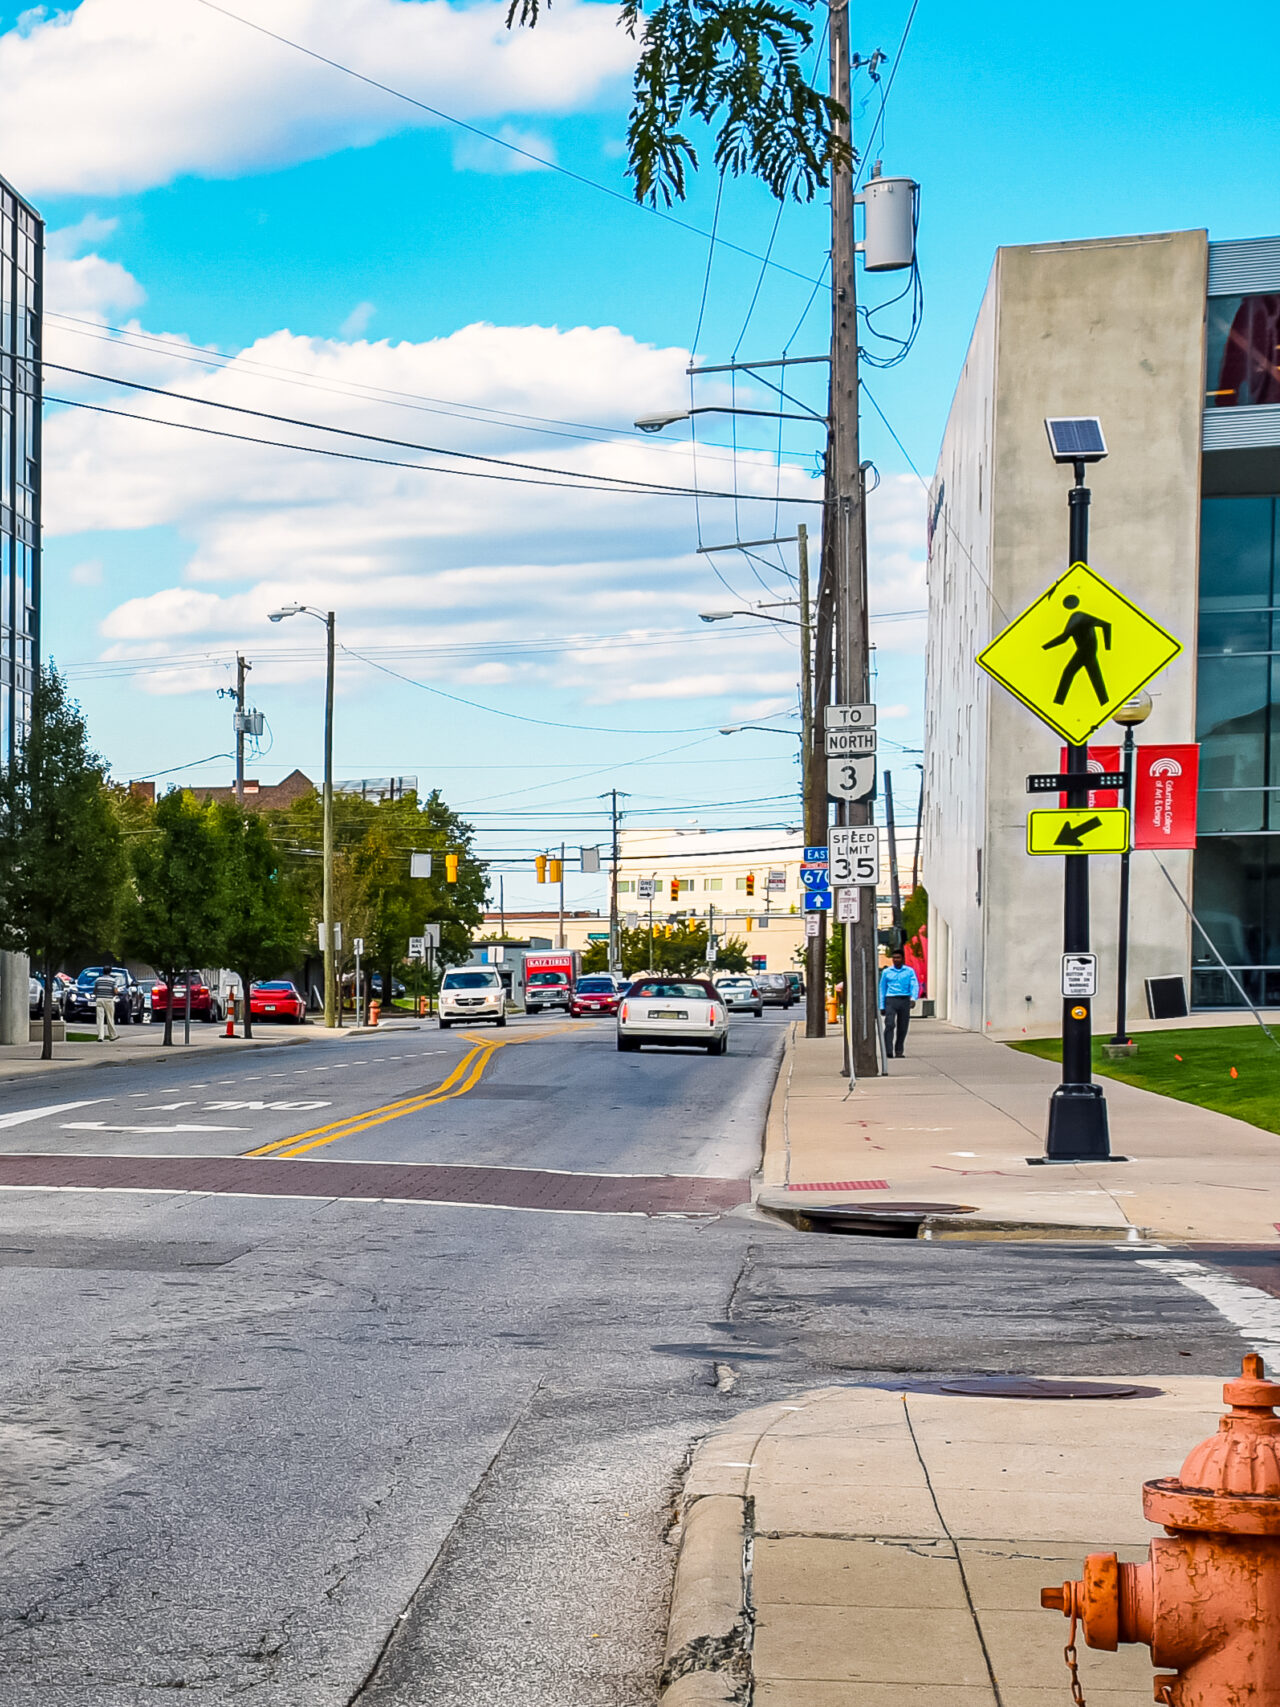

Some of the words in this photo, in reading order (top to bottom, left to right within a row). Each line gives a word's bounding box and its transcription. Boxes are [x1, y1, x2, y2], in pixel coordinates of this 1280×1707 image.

[839, 709, 862, 723] TO
[829, 734, 873, 749] NORTH
[839, 765, 858, 791] 3
[1155, 780, 1164, 788] of
[1154, 789, 1163, 799] Art
[1164, 780, 1174, 811] Columbus
[1152, 806, 1163, 828] Design
[1162, 811, 1173, 835] College
[833, 833, 875, 844] SPEED
[837, 845, 870, 856] LIMIT
[834, 857, 875, 880] 35
[133, 1101, 333, 1111] ONLY
